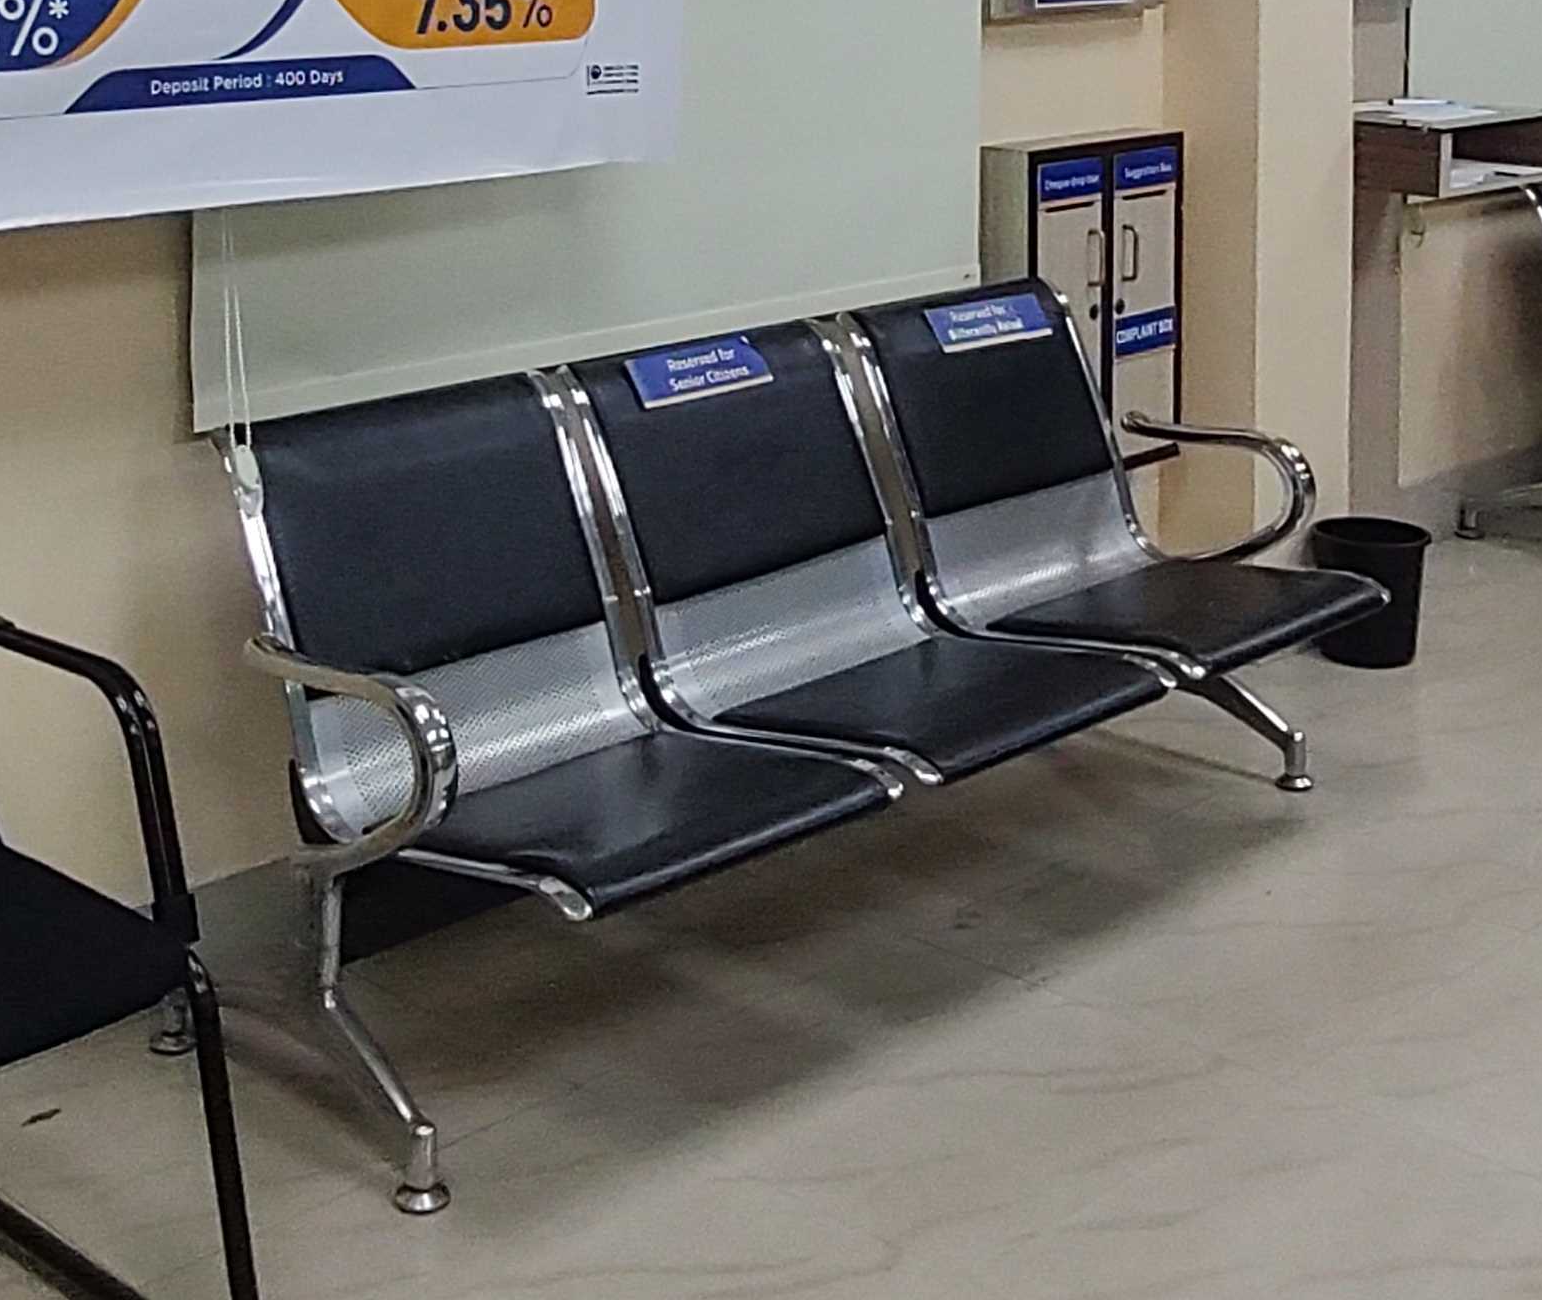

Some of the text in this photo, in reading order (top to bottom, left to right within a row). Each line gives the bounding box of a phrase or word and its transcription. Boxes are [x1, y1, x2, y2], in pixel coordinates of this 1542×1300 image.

[150, 77, 209, 95] Deposit
[214, 73, 262, 91] Period
[275, 71, 306, 86] 400
[310, 69, 344, 86] Days
[1116, 318, 1174, 344] COMPLAINT BOX
[666, 348, 735, 373] Reserved for
[669, 365, 751, 392] Senior Citizens
